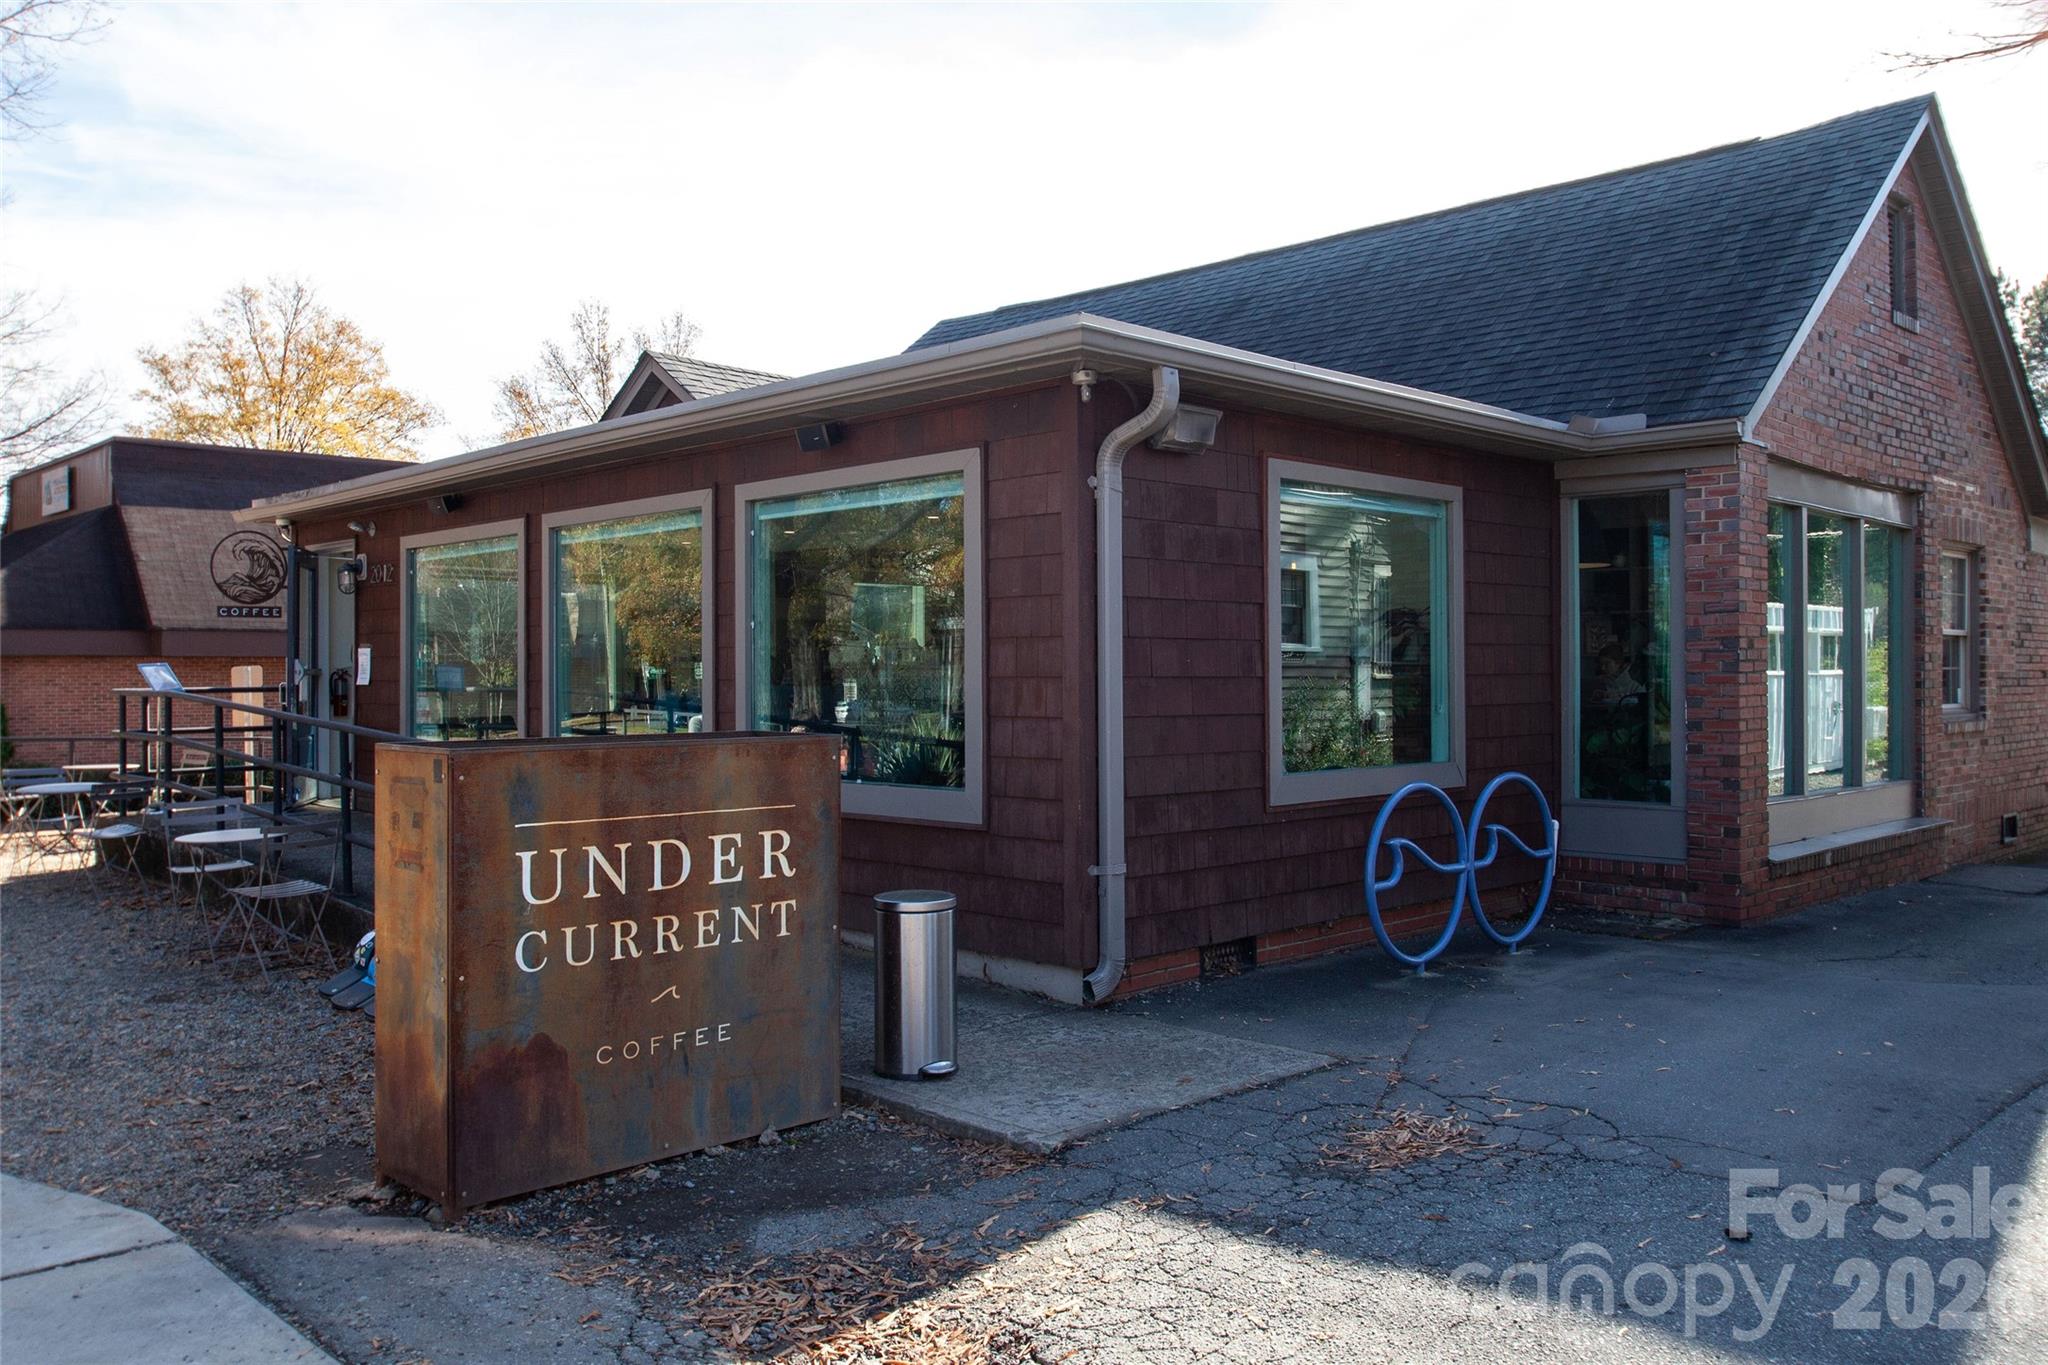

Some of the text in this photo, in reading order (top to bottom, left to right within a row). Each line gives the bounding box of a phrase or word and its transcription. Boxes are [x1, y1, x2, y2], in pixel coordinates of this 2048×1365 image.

[370, 563, 394, 583] 2012
[219, 607, 280, 617] COFFEE
[515, 829, 797, 905] UNDER
[515, 899, 797, 973] CURRENT
[596, 1023, 731, 1064] COFFEE
